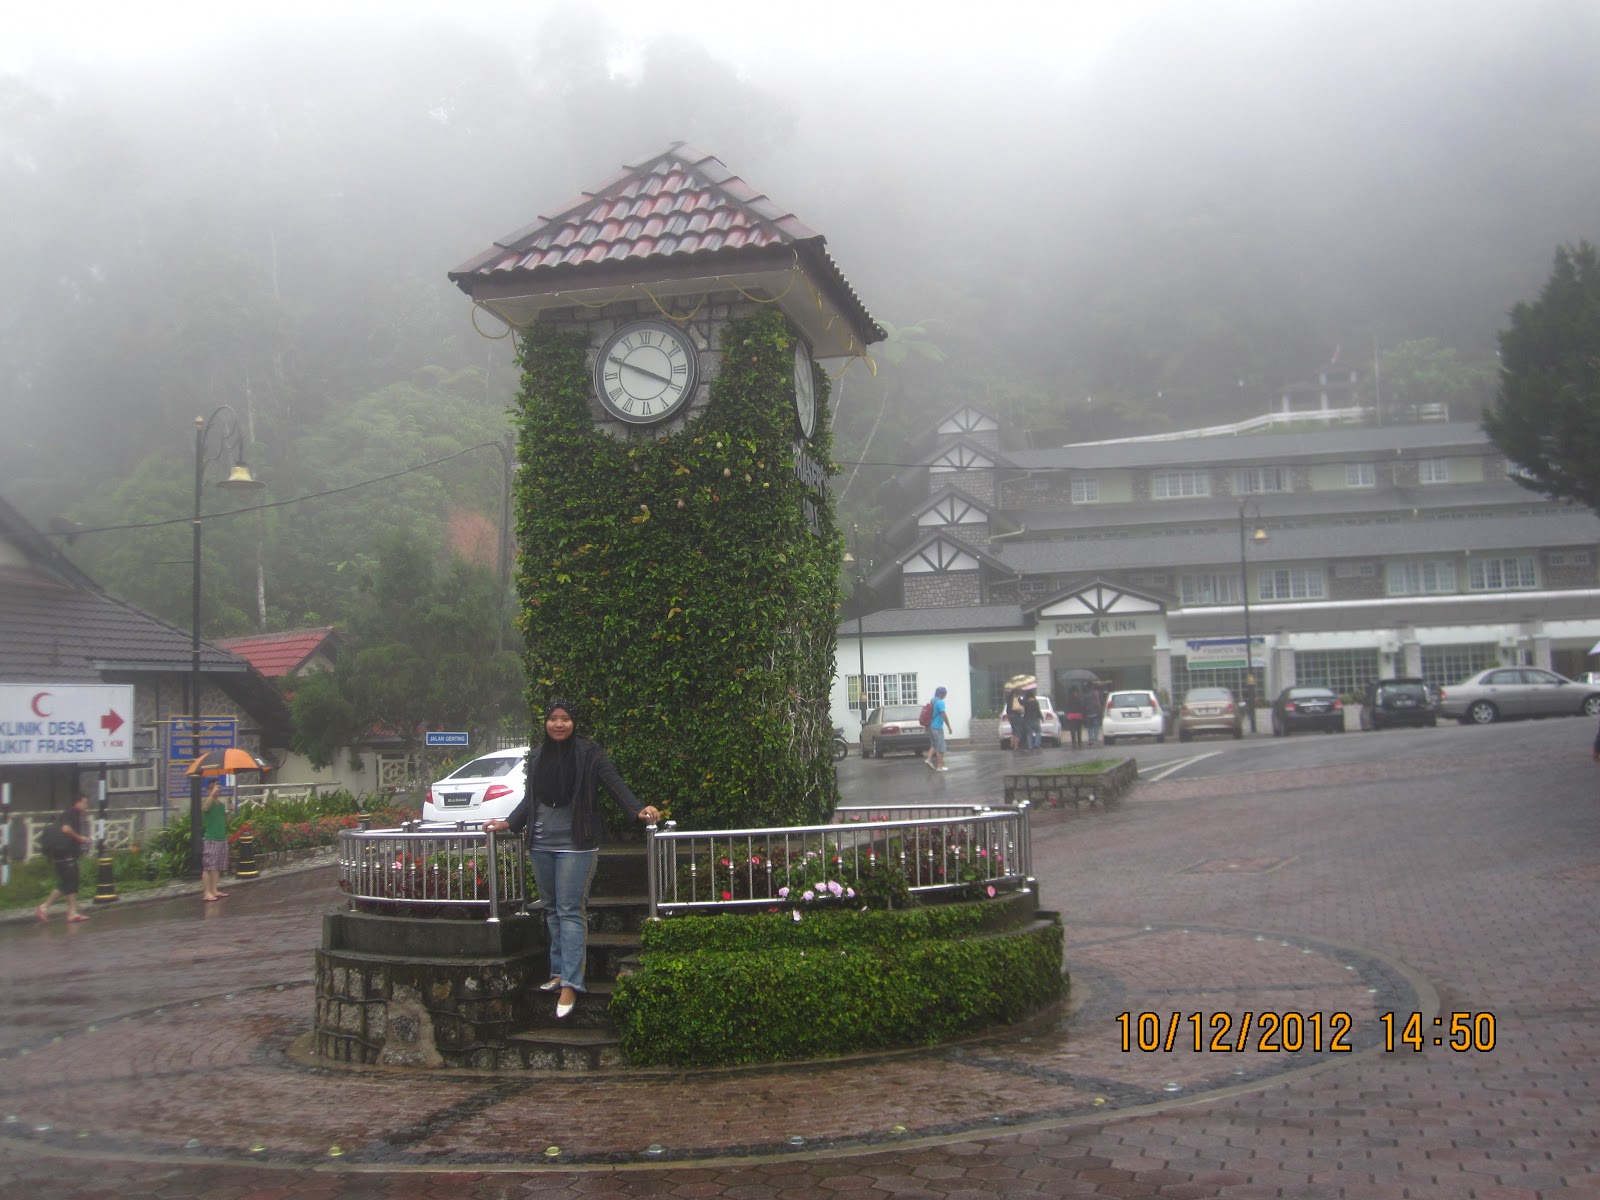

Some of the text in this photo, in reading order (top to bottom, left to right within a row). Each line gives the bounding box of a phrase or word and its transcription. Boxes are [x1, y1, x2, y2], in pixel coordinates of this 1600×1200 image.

[1055, 618, 1137, 636] PUNCK INN
[48, 721, 86, 736] DESA
[38, 738, 94, 753] FRASER
[110, 740, 123, 748] KM
